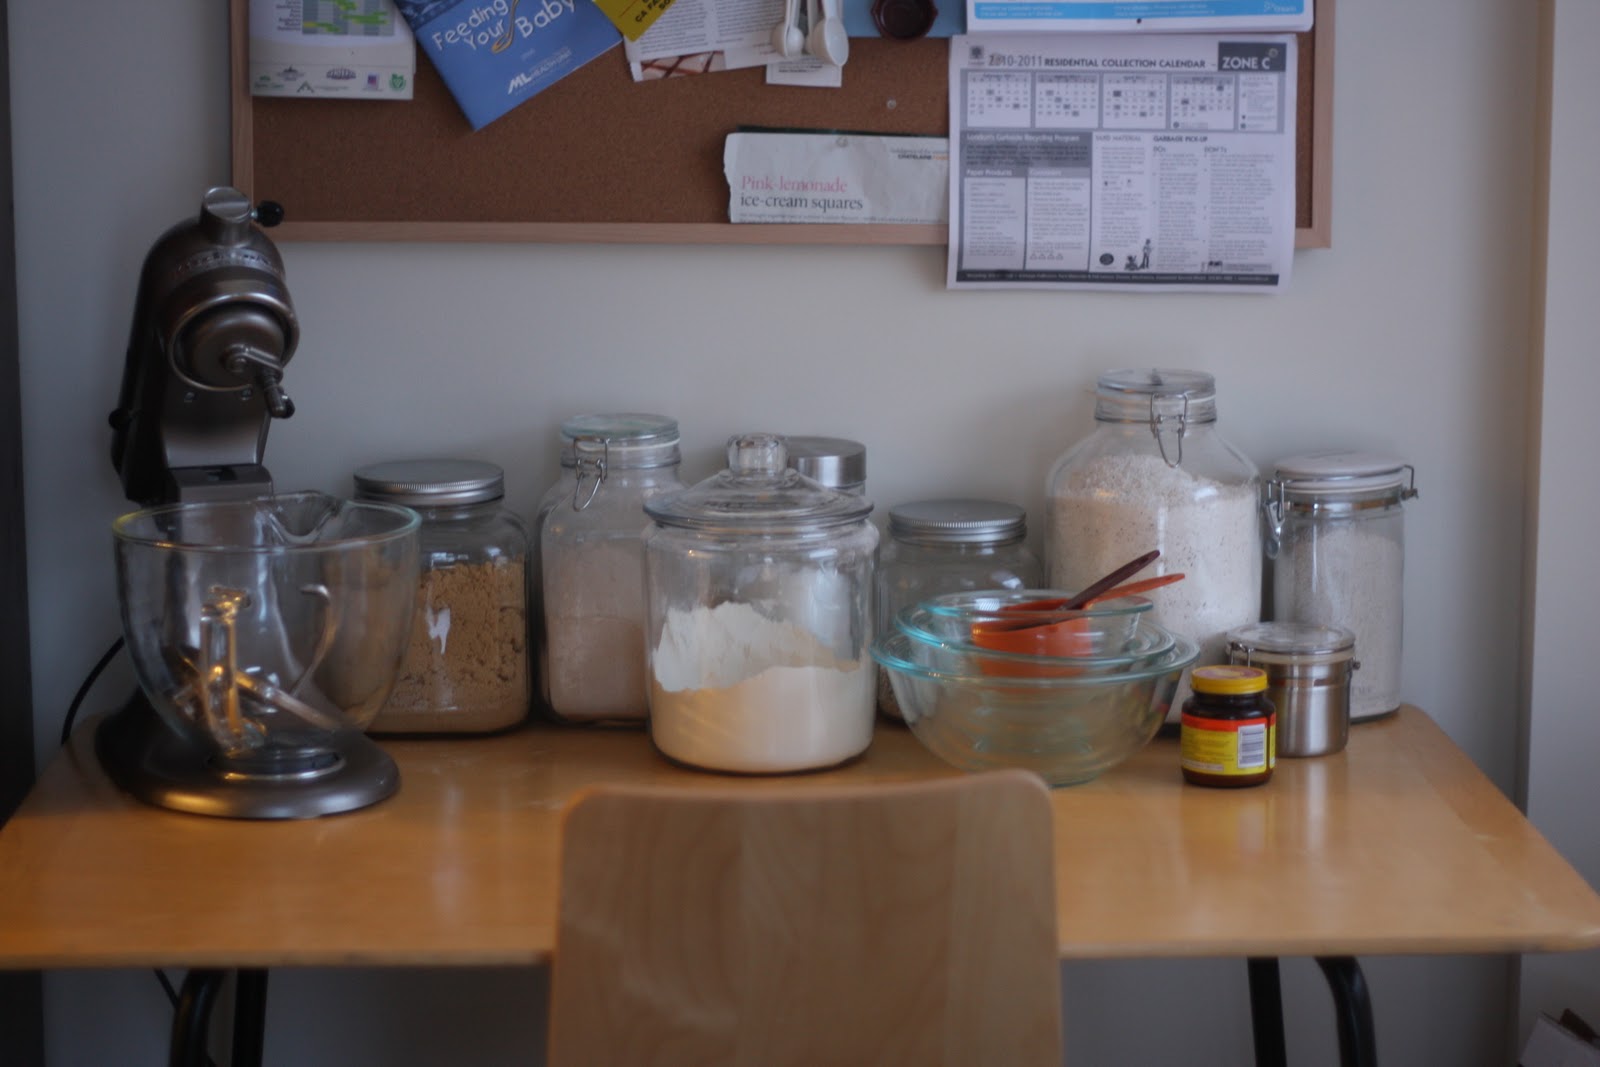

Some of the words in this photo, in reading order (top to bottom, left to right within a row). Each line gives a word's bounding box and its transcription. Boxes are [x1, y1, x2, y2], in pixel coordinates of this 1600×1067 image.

[432, 0, 509, 50] Feeding
[463, 20, 505, 50] Your
[1044, 58, 1098, 67] RESIDENTIAL
[1101, 58, 1156, 68] COLLECTION
[1159, 59, 1206, 69] CALENDAR
[1221, 56, 1258, 70] ZONE
[1261, 57, 1271, 70] C
[1153, 135, 1184, 143] GARBAGE
[741, 175, 848, 193] Pink-lemonade
[740, 192, 809, 209] ice-cream
[810, 198, 864, 214] squares
